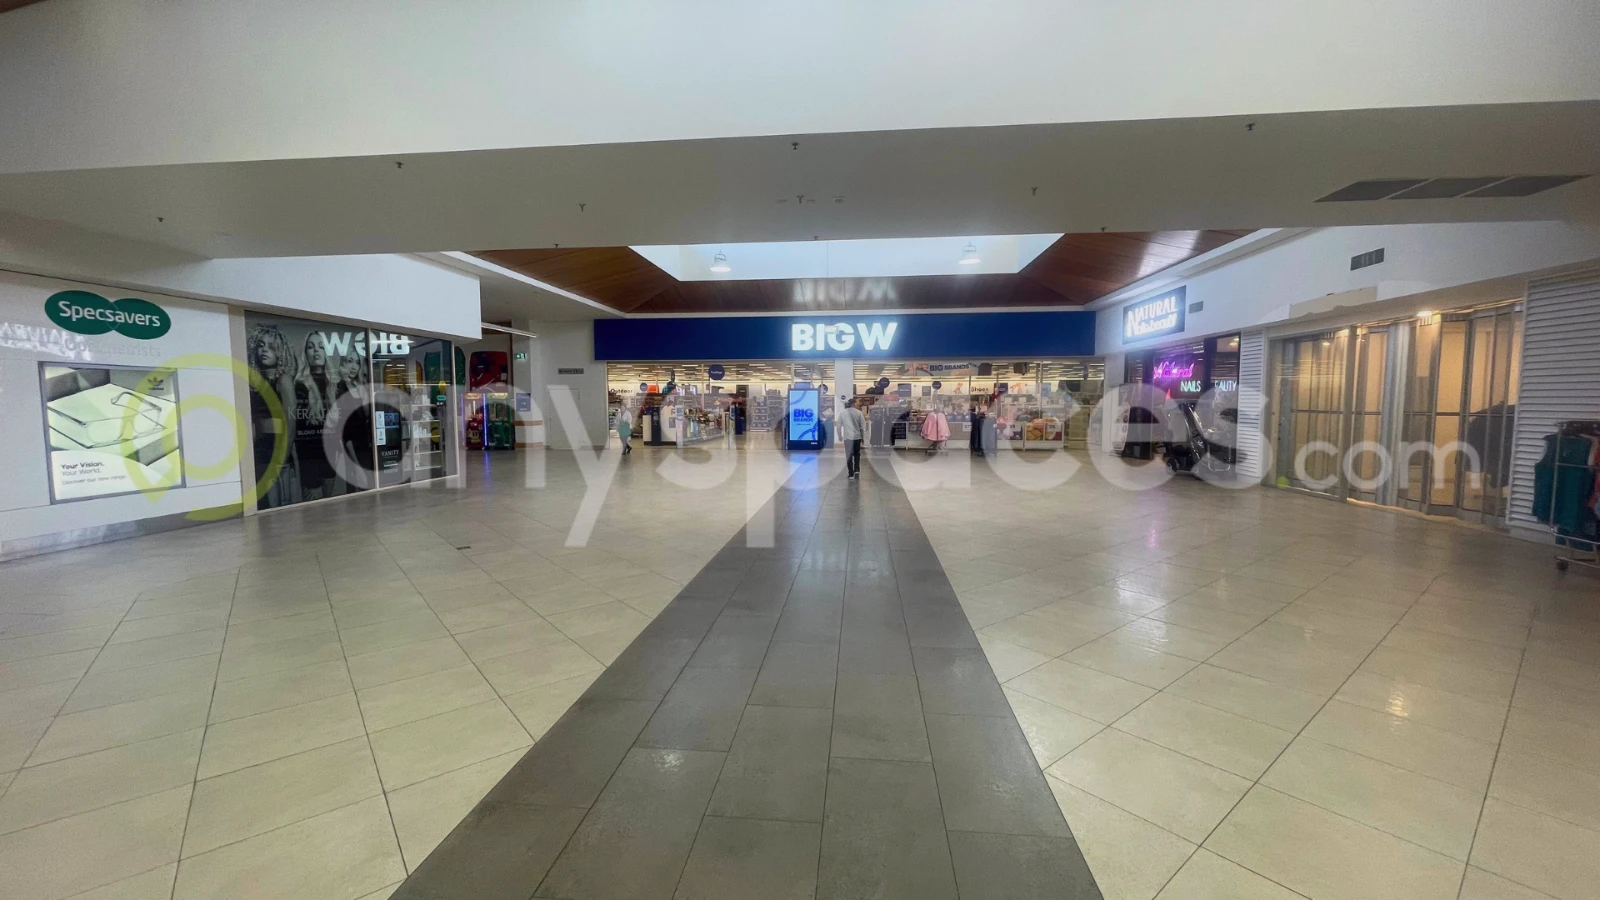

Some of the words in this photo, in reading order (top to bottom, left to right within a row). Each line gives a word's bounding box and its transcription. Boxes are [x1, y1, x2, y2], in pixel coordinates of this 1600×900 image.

[58, 300, 161, 327] Specsavers
[1128, 296, 1178, 325] NATURAL
[792, 323, 855, 351] BIG
[856, 322, 898, 350] W
[1180, 381, 1202, 392] NAILS
[793, 408, 814, 418] BIG
